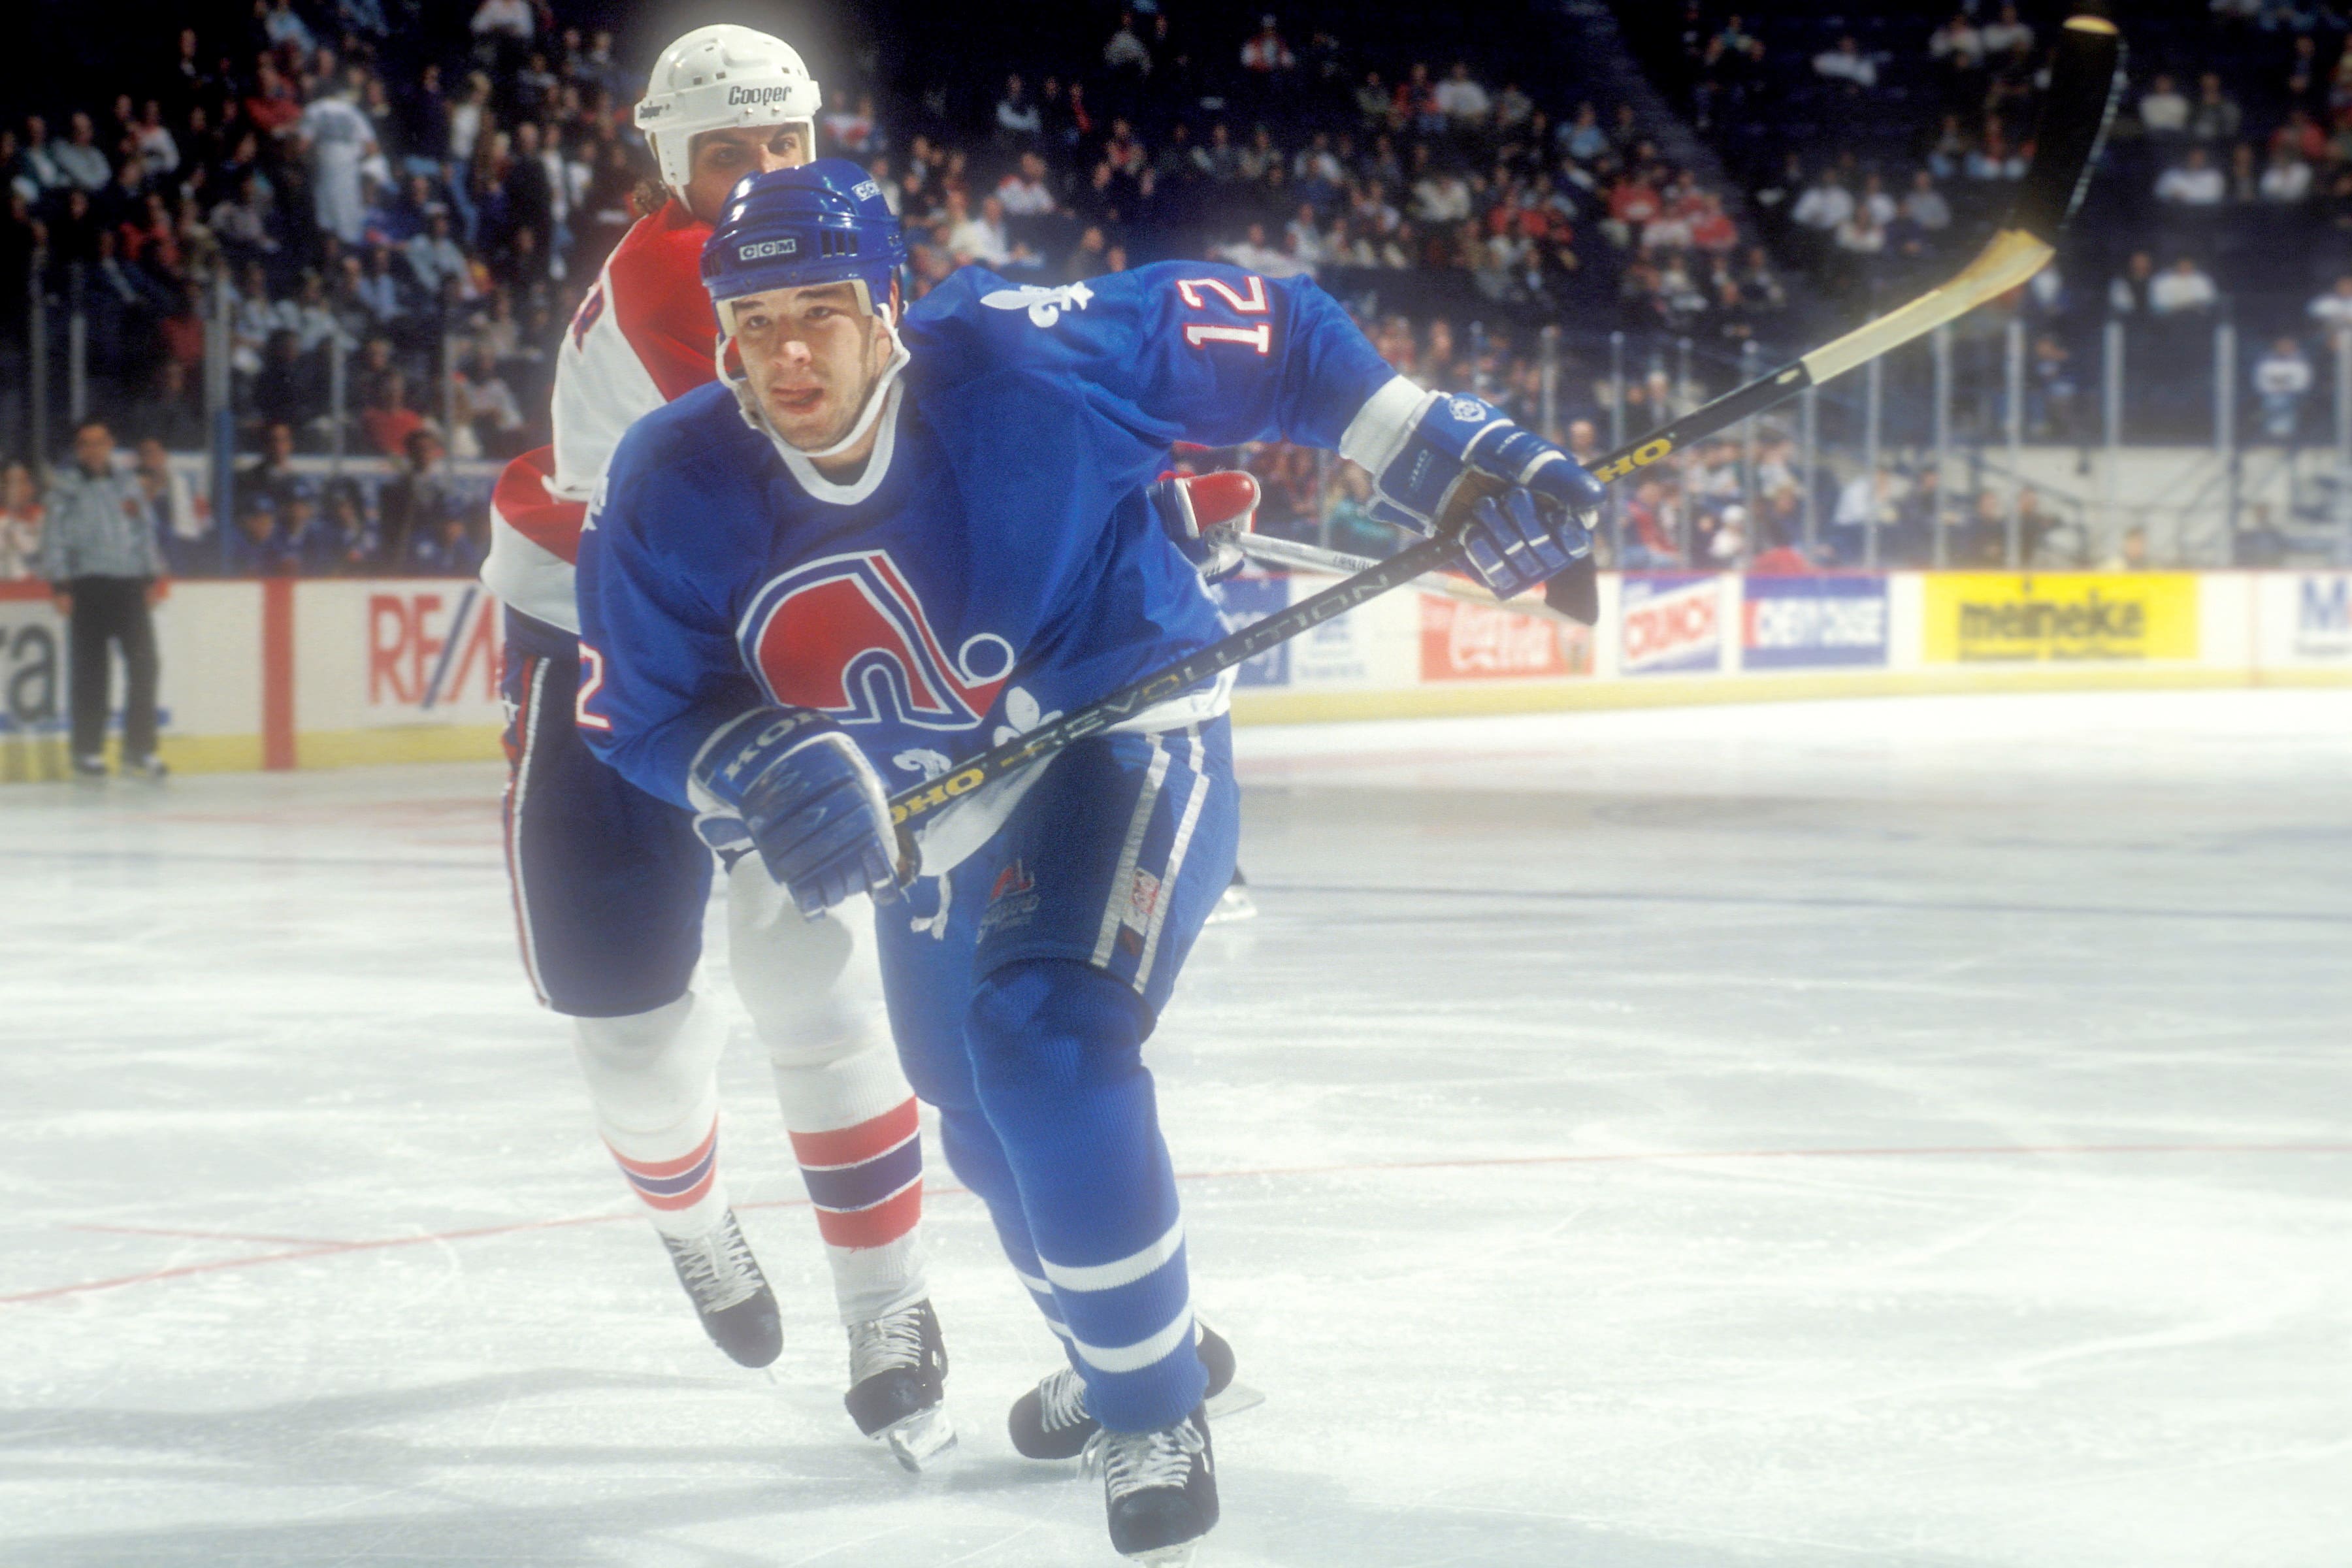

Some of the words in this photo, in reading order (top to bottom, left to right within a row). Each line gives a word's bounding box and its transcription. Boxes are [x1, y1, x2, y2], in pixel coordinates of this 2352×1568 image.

[728, 85, 792, 106] Cooper
[742, 239, 796, 259] CCM
[1177, 274, 1271, 357] 12
[1593, 438, 1672, 483] HO
[0, 624, 57, 723] a
[889, 768, 985, 826] OHO
